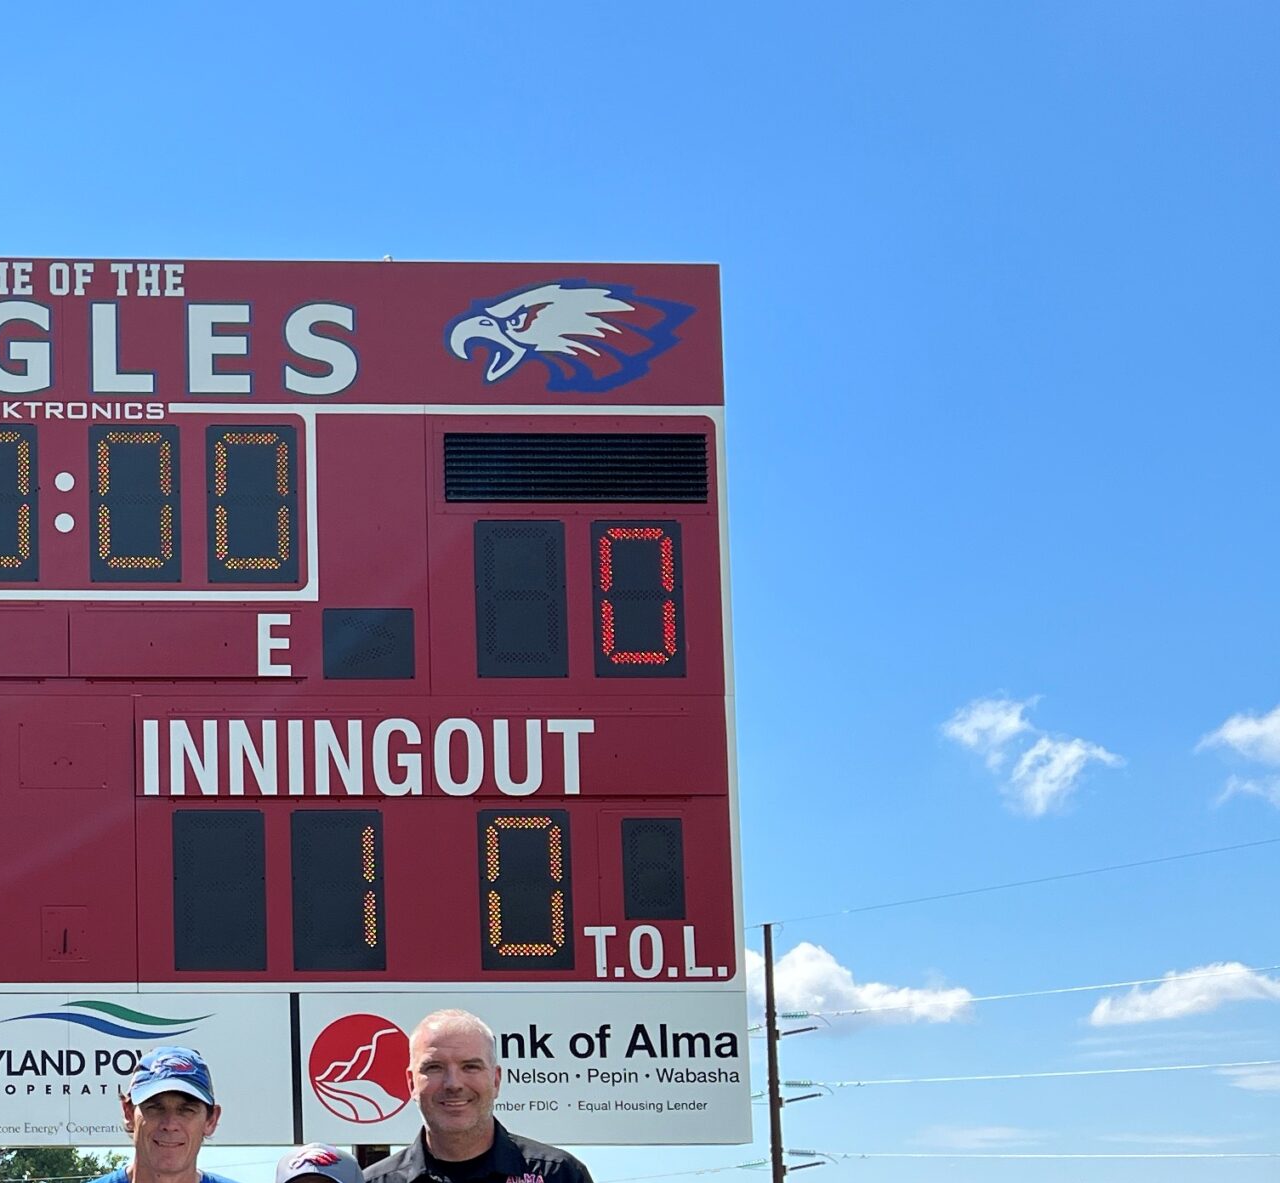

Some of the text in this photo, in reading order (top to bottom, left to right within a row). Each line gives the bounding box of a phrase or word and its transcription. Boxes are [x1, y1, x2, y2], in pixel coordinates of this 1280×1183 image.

[49, 262, 94, 296] OF
[110, 263, 185, 297] THE
[598, 526, 677, 666] 0
[257, 613, 292, 677] E
[142, 718, 423, 796] INNING
[432, 717, 596, 796] OUT
[486, 816, 566, 957] 0
[584, 925, 729, 978] T.O.L.
[494, 1023, 739, 1059] nk of Alma
[507, 1067, 740, 1087] Nelson Pepin Wabasha
[66, 1121, 125, 1136] Cooperativ
[495, 1100, 708, 1114] mber FDIC Equal Housing Lender
